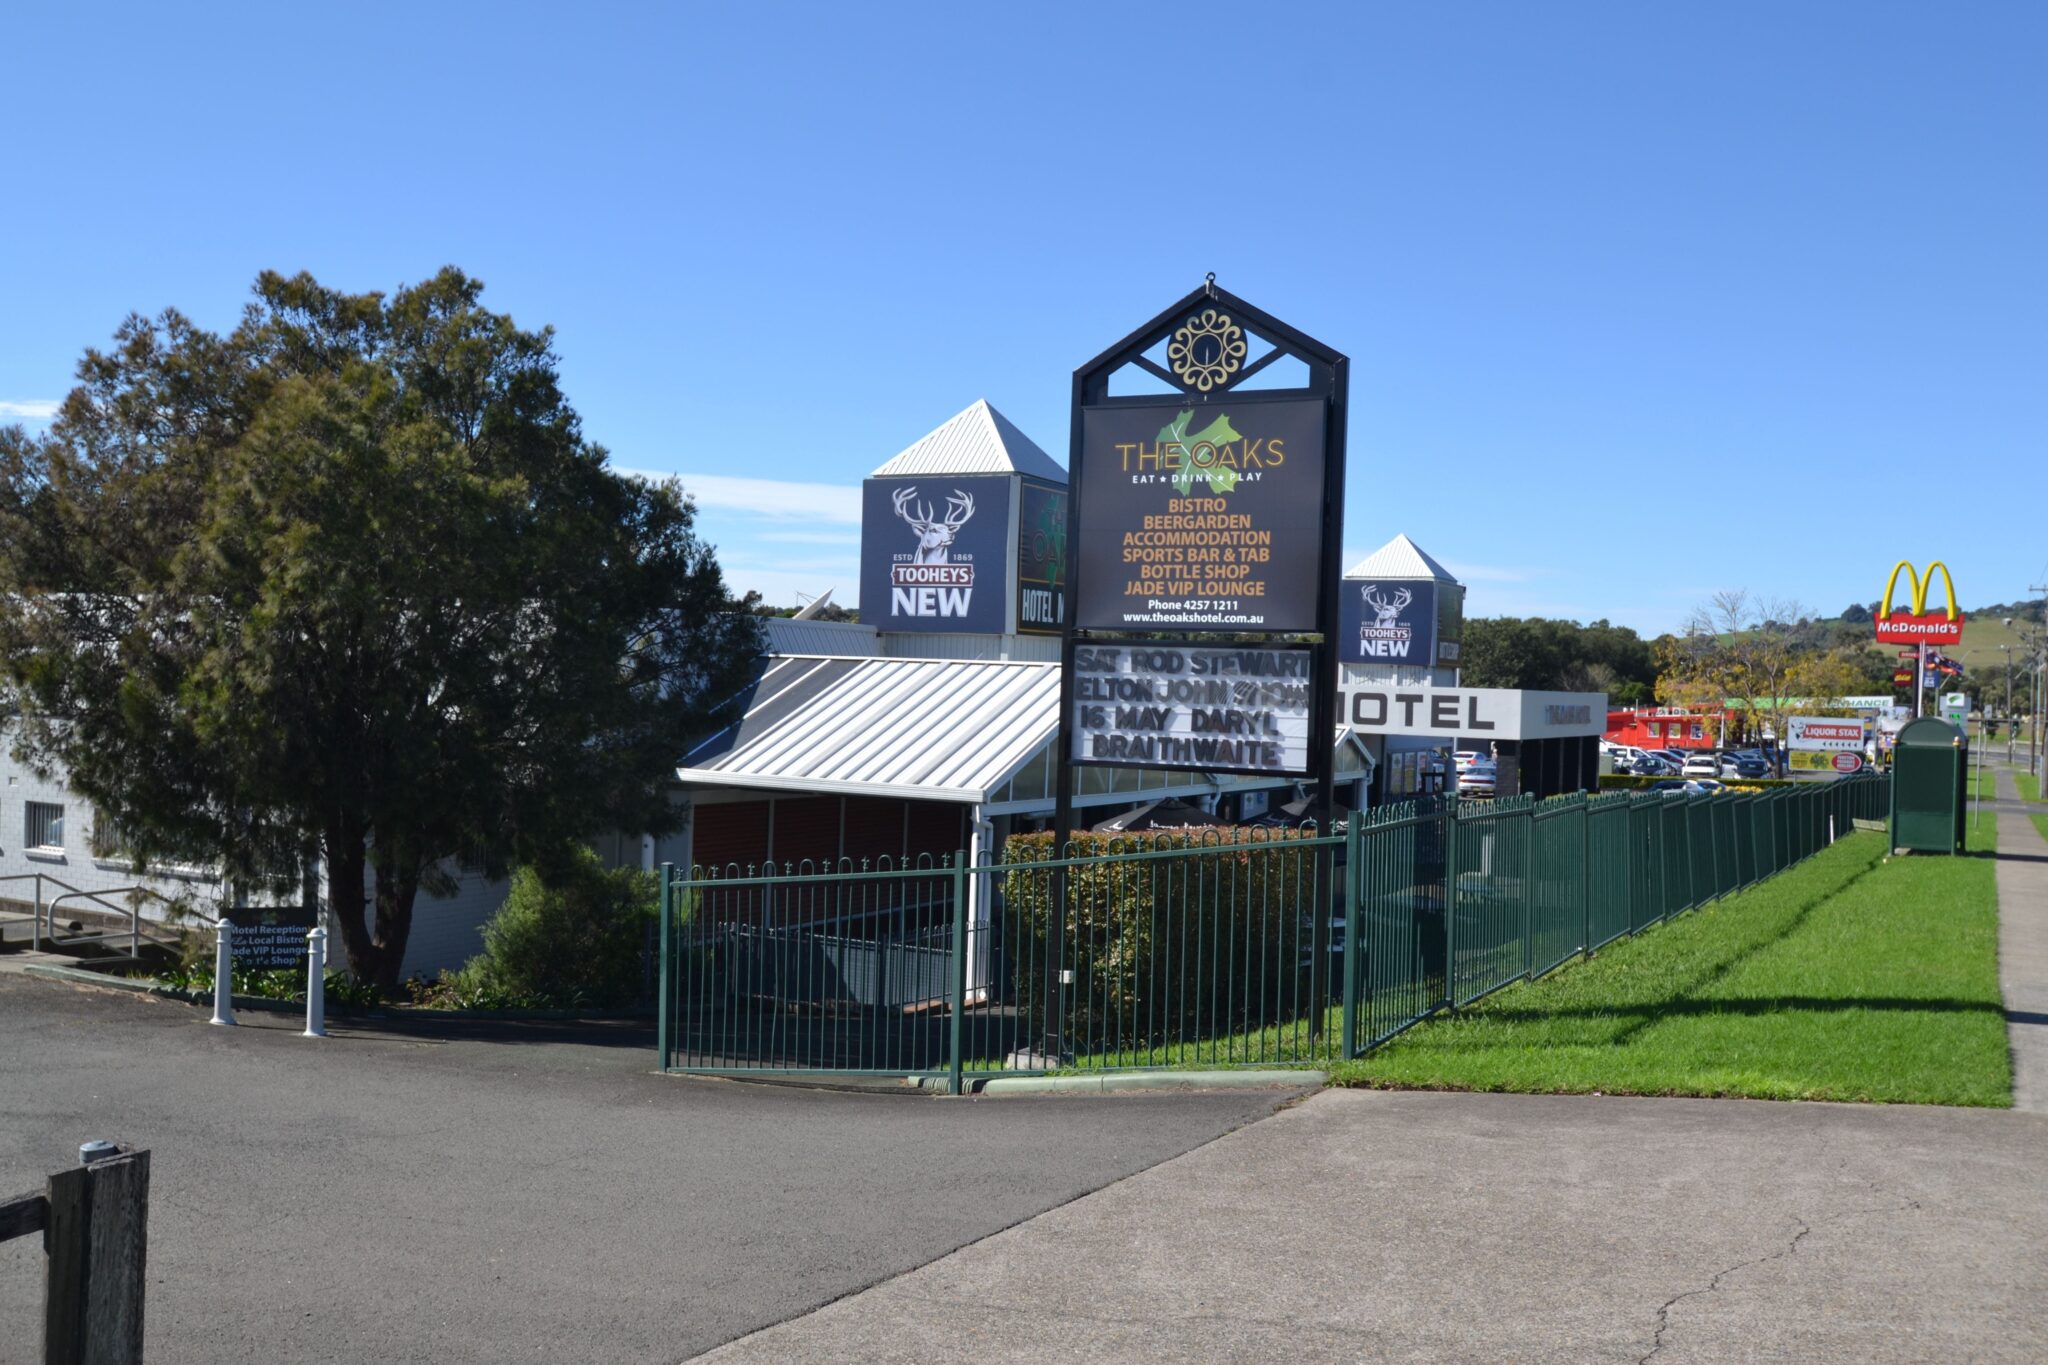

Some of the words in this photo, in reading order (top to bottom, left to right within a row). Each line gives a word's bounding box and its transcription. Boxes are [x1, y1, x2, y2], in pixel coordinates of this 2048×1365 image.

[1115, 442, 1183, 471] THE
[1190, 438, 1284, 470] OAKS
[1132, 475, 1155, 484] EAT
[1171, 473, 1213, 483] DRINK
[1229, 472, 1262, 482] PLAY
[1168, 498, 1227, 513] BISTRO
[1143, 515, 1251, 530] BEERGARDEN
[1122, 531, 1271, 546] ACCOMMODATION
[1122, 548, 1183, 563] SPORTS
[1187, 548, 1220, 562] BAR
[1223, 548, 1236, 562] &
[1238, 548, 1270, 562] TAB
[896, 567, 969, 583] TOOHEYS
[1140, 565, 1201, 579] BOTTLE
[1204, 564, 1250, 579] SHOP
[1124, 581, 1164, 596] JADE
[1168, 581, 1194, 595] VIP
[1198, 581, 1265, 596] LOUNGE
[891, 588, 973, 617] NEW
[1022, 588, 1053, 623] HOTEL
[1148, 600, 1182, 610] Phone
[1183, 600, 1210, 610] 4257
[1212, 600, 1238, 610] 1211
[1123, 612, 1264, 624] www.theoakshotel.com.au
[1363, 629, 1408, 639] TOOHEYS
[1877, 622, 1958, 634] McDonald's
[1360, 640, 1410, 657] NEW
[1075, 649, 1121, 672] SAT
[1131, 649, 1184, 673] ROD
[1190, 651, 1309, 677] STEWART
[1075, 677, 1152, 702] ELTON
[1157, 679, 1228, 704] JOHN
[1081, 705, 1105, 729] 16
[1115, 707, 1171, 731] MAY
[1191, 708, 1278, 736] DARYL
[1805, 726, 1837, 737] LIQUOR
[1838, 728, 1860, 738] STAX
[1092, 735, 1278, 766] BRAITHWAITE
[260, 925, 307, 935] Reception
[248, 936, 274, 944] Local
[276, 936, 304, 944] Bistro
[231, 947, 251, 955] ade
[253, 946, 270, 954] VIP
[271, 946, 307, 955] Lounge
[271, 956, 295, 966] Shop
